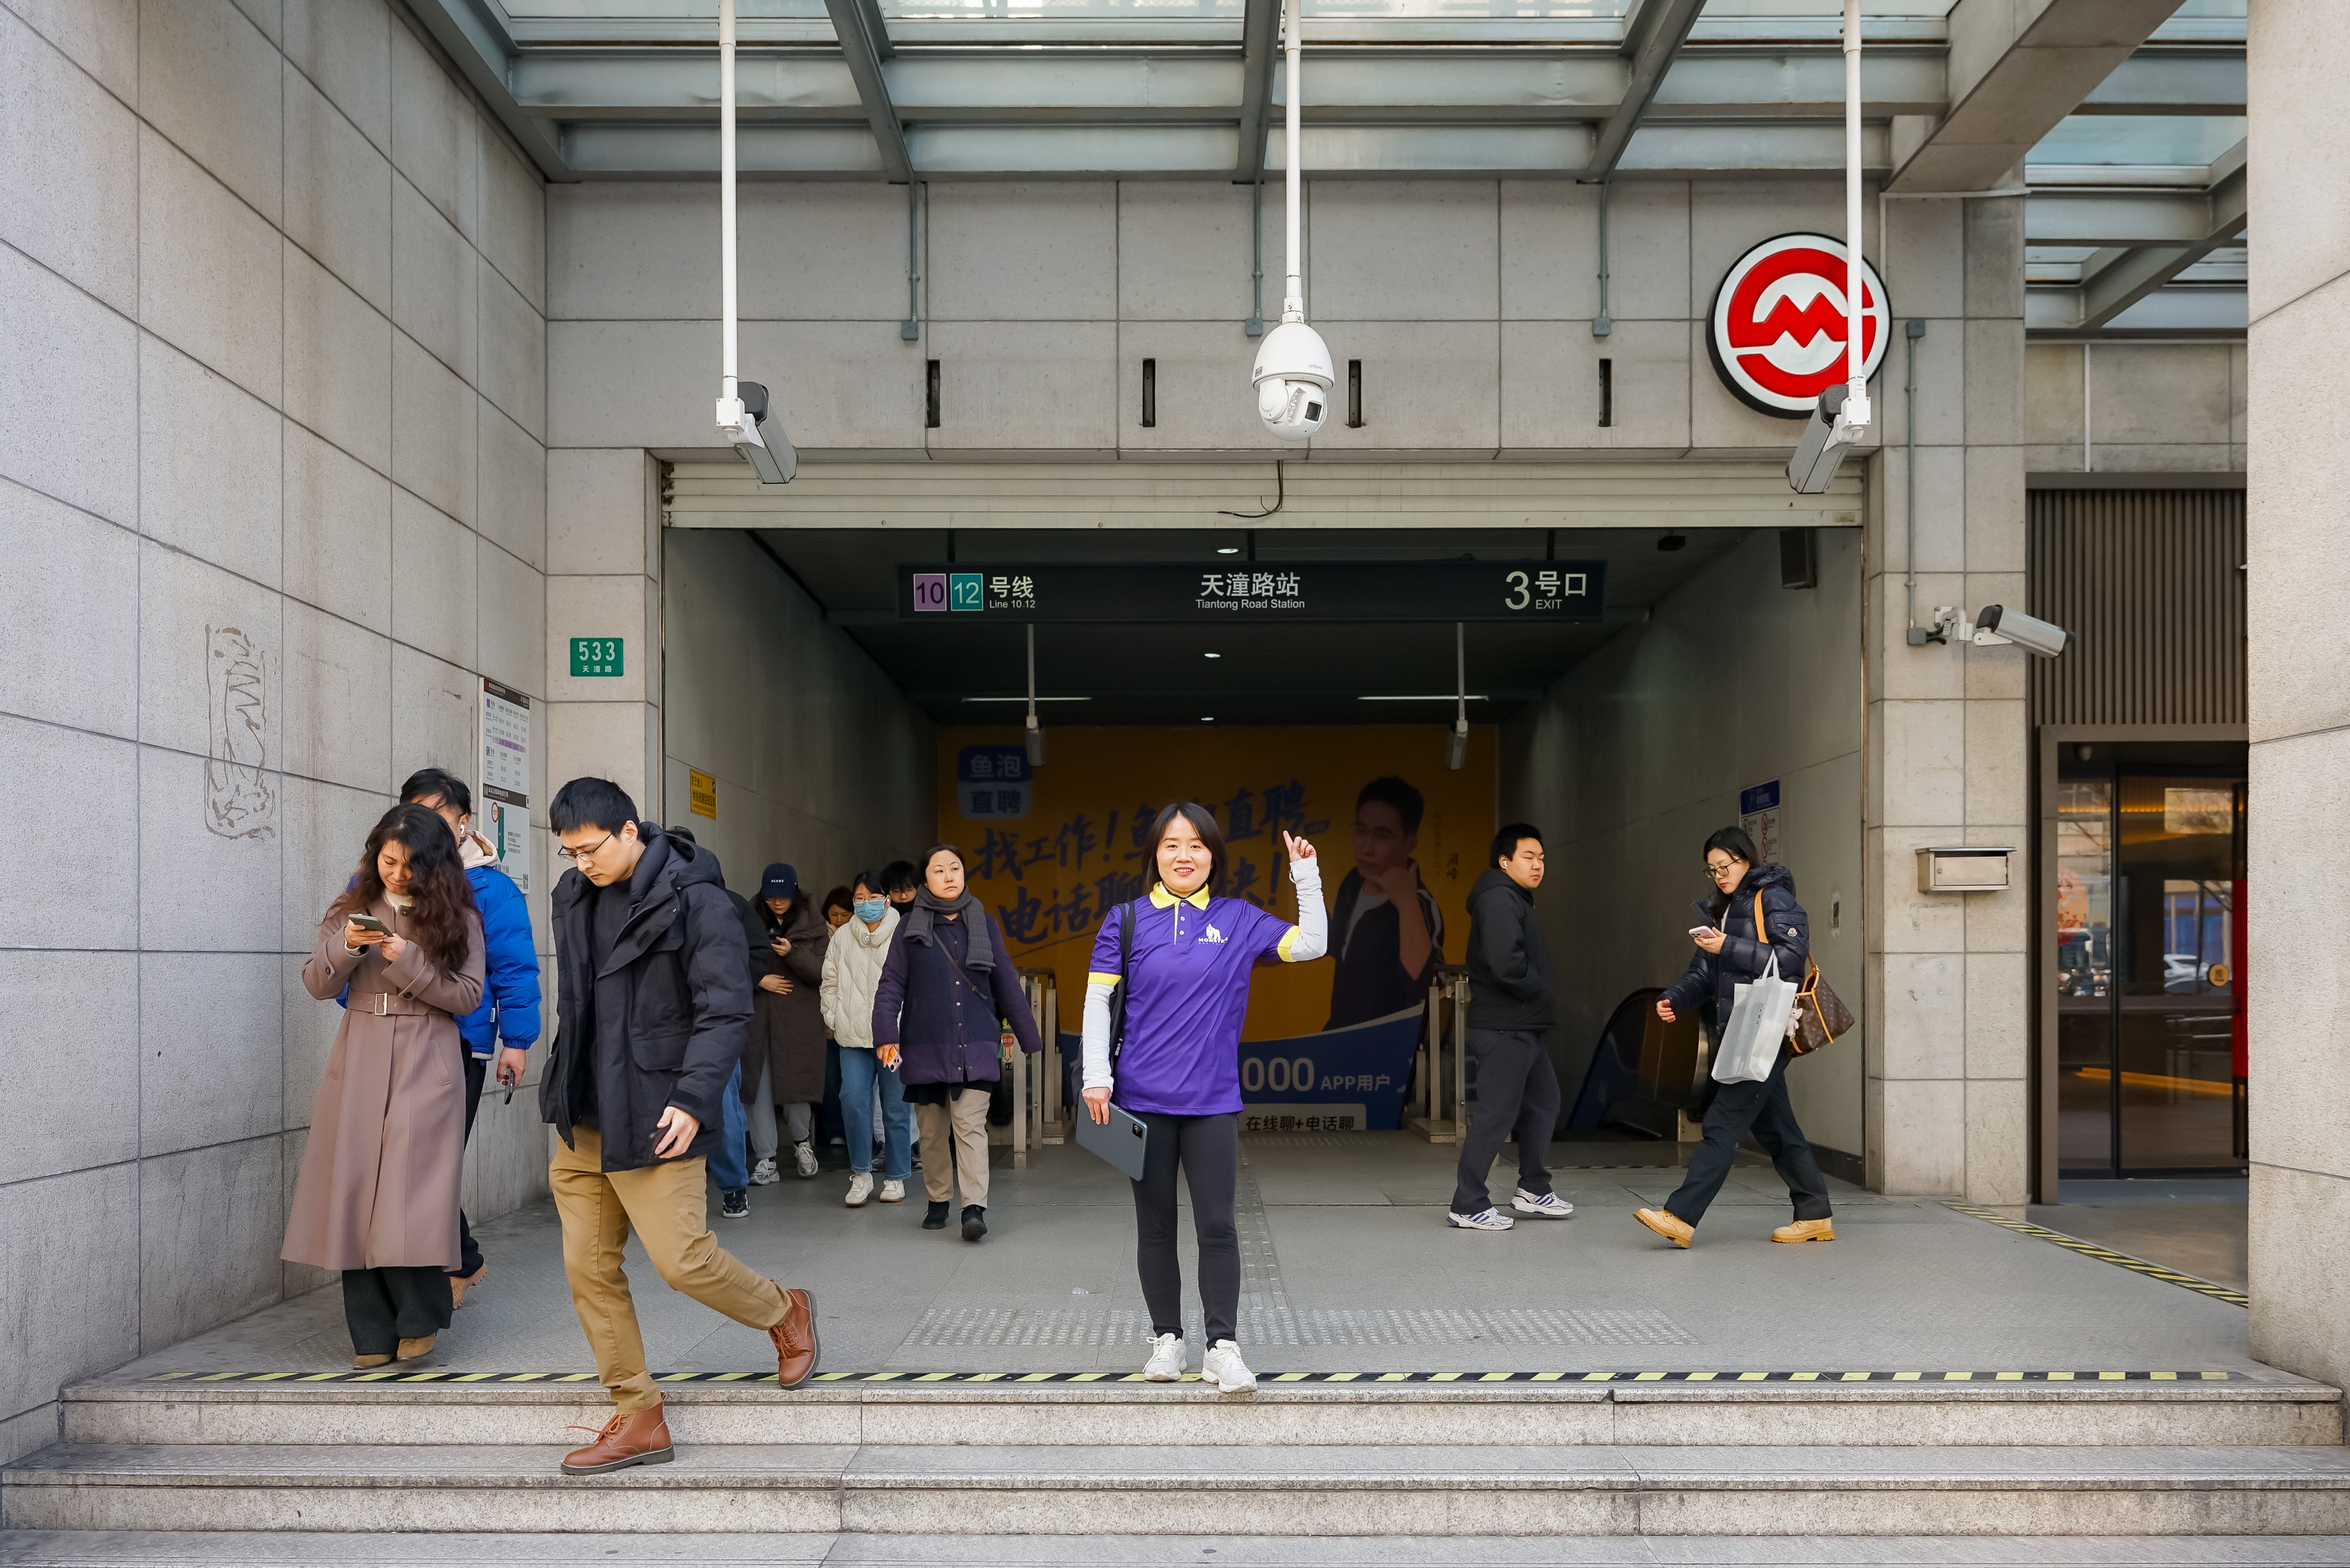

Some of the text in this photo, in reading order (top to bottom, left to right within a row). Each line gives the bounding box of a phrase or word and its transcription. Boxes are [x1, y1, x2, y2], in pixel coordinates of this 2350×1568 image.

[916, 576, 1034, 604] 10 12 号线
[1200, 572, 1300, 597] 天潼路站
[989, 599, 1036, 609] Line 10.12
[1195, 598, 1305, 611] Tiantong Road Station
[1535, 599, 1563, 609] EXIT
[579, 641, 616, 661] 533
[969, 753, 1022, 778] 鱼泡
[970, 789, 1021, 814] 直聘
[1320, 1074, 1390, 1092] APP用户
